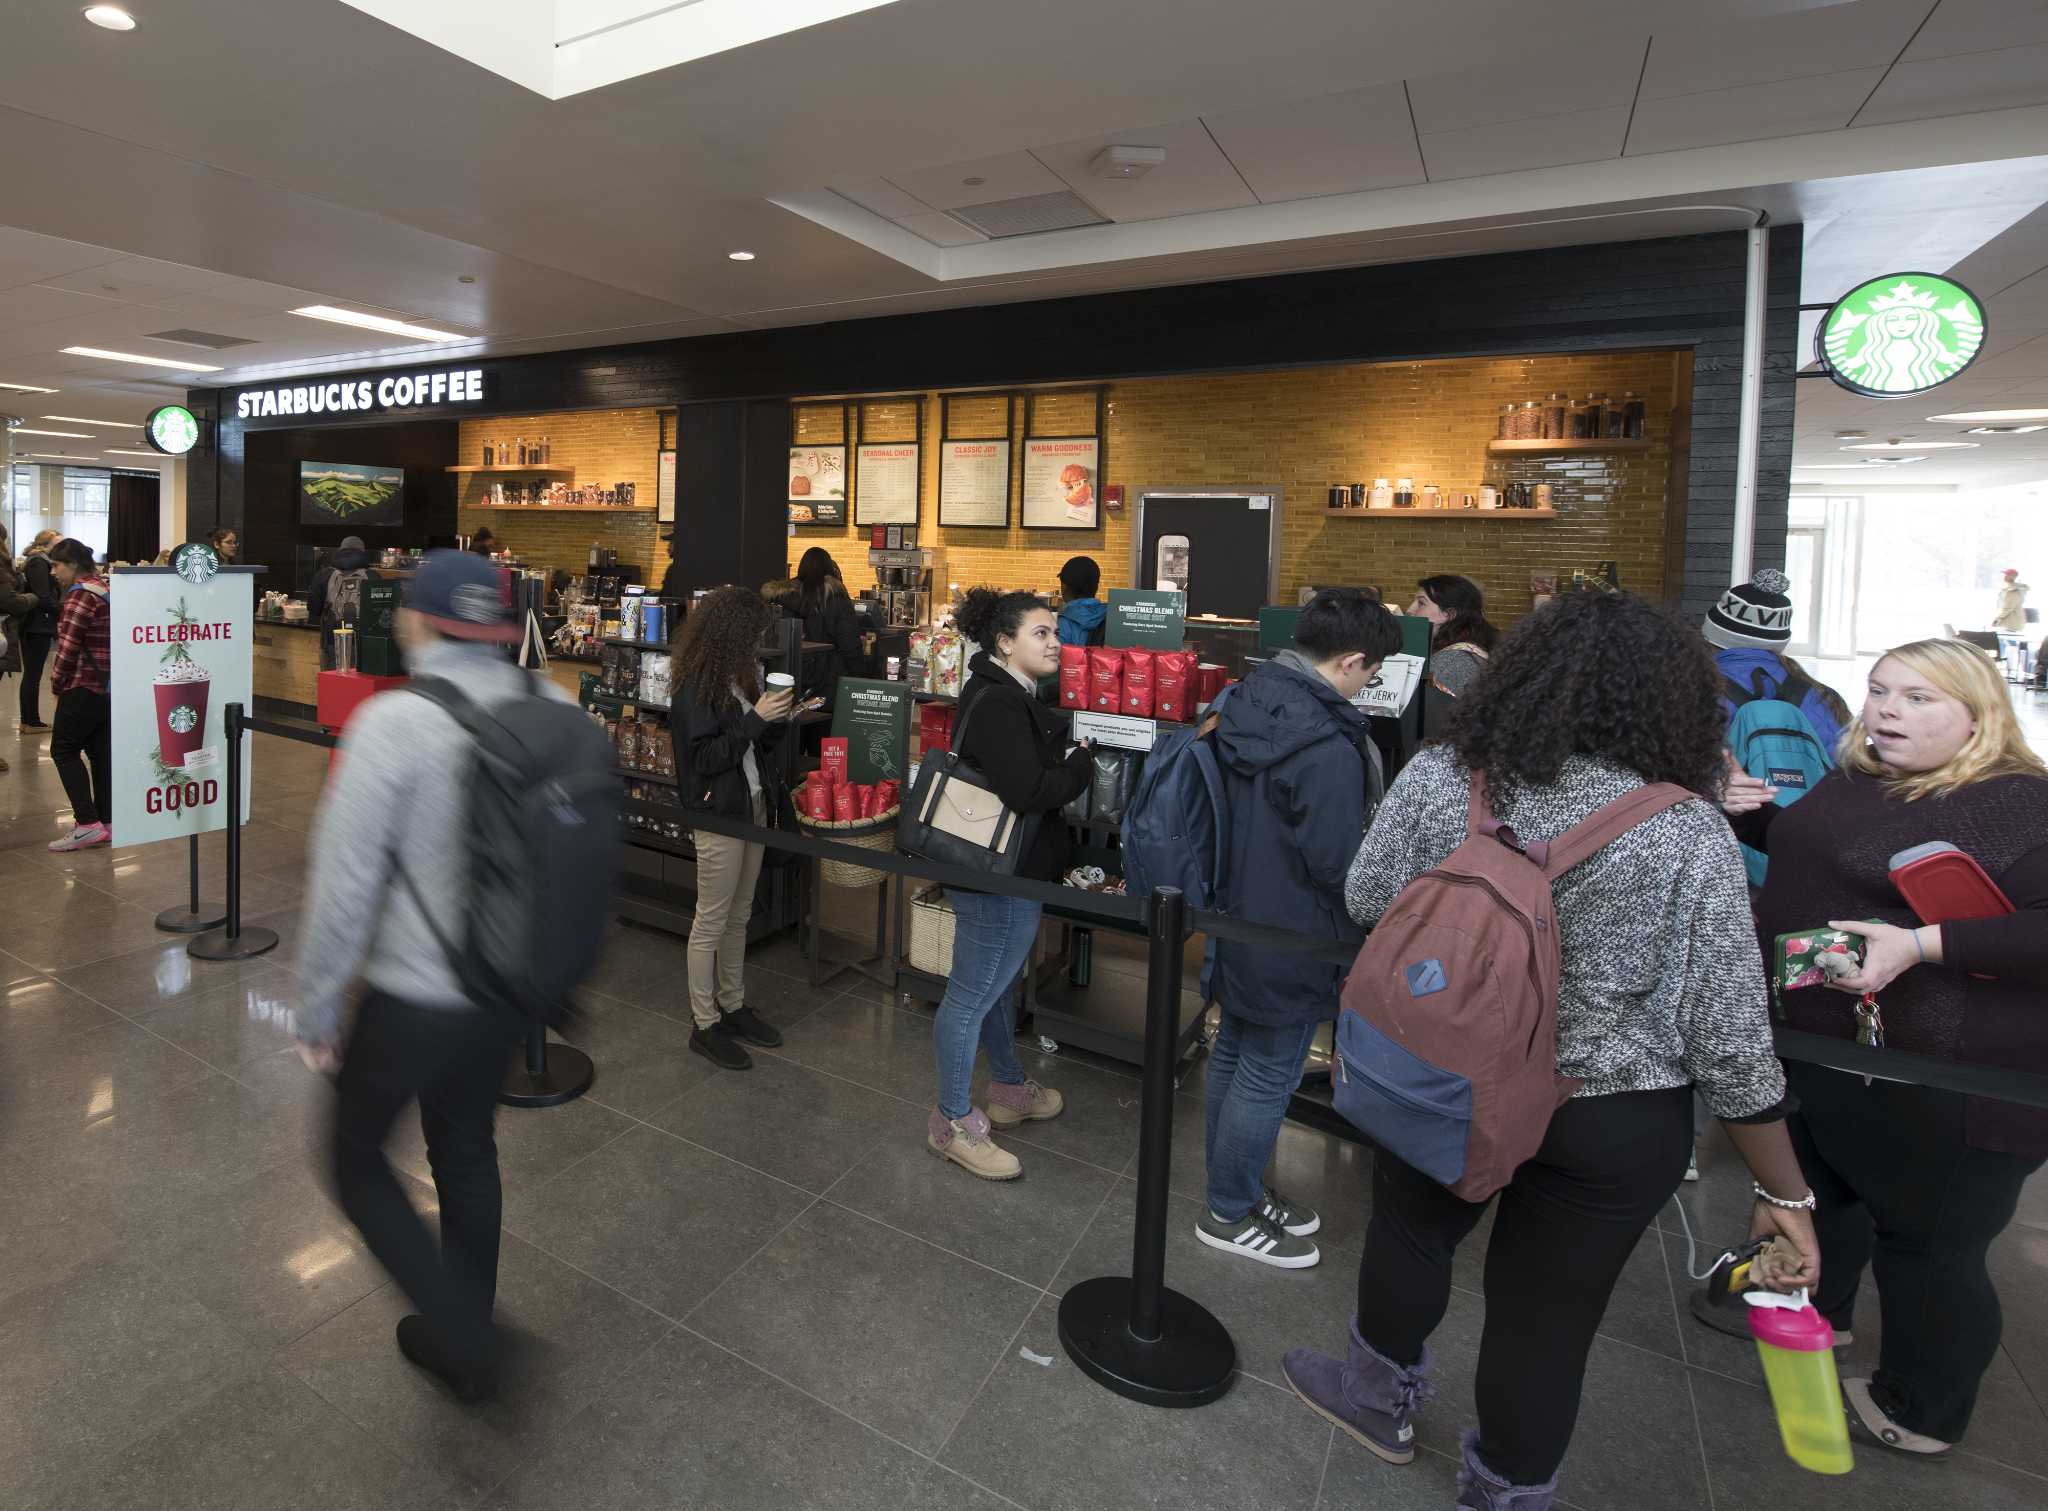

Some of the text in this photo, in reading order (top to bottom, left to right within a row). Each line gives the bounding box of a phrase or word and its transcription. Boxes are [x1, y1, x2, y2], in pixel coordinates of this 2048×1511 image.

[237, 370, 483, 418] STARBUCKS COFFEE
[895, 449, 913, 457] CHEER
[955, 446, 983, 454] CLASSIC
[1031, 444, 1093, 453] WARM GOODNESS
[1119, 605, 1174, 615] CHRISTMAS BLEND
[132, 623, 232, 644] CELEBRATE
[851, 692, 899, 703] CHRISTMAS BLEND
[1373, 689, 1399, 702] JERKY
[146, 779, 218, 814] GOOD
